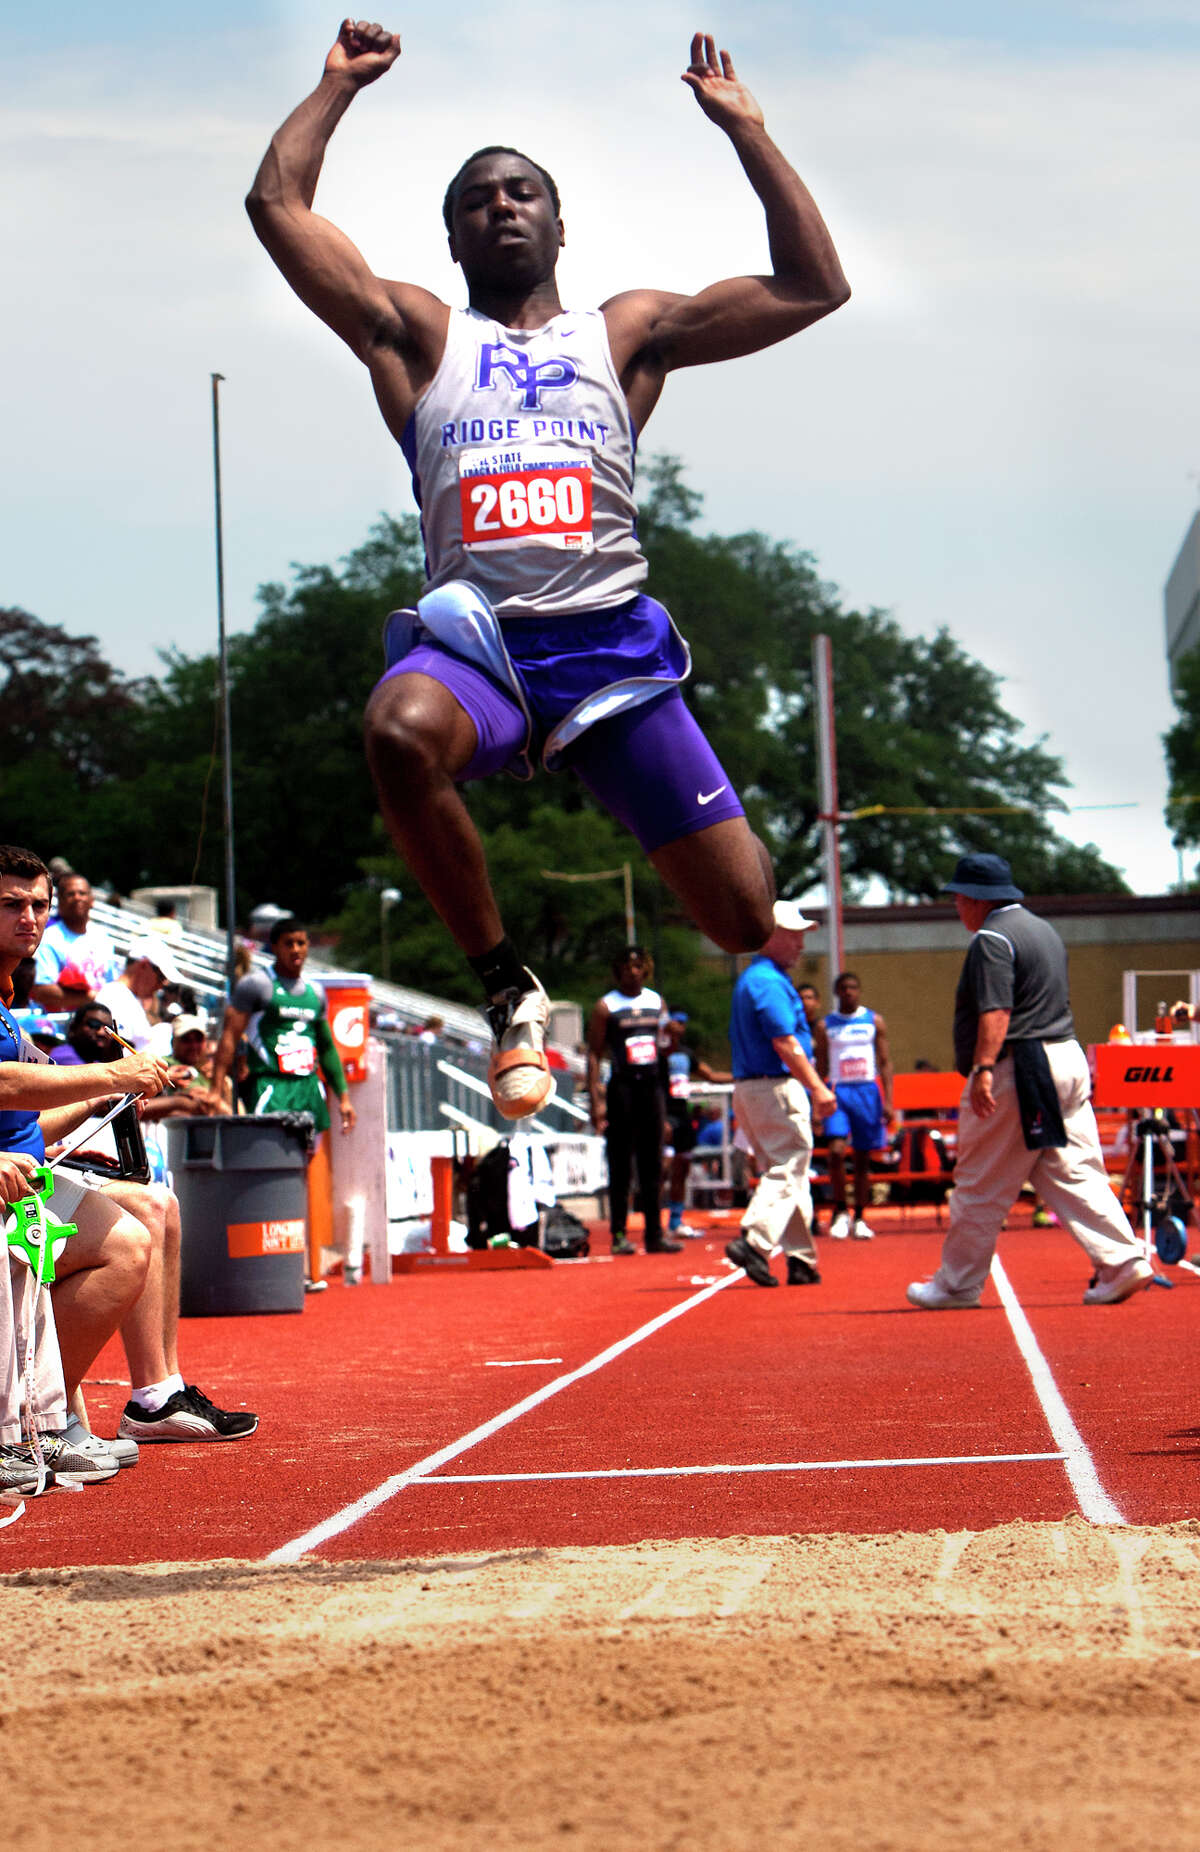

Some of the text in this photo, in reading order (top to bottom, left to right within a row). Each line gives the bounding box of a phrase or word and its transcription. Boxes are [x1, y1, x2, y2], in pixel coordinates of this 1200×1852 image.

[473, 342, 581, 411] RP
[441, 419, 609, 447] RIDGE POINT
[492, 451, 522, 464] STATE
[470, 476, 584, 532] 2660
[1124, 1066, 1174, 1082] GILL
